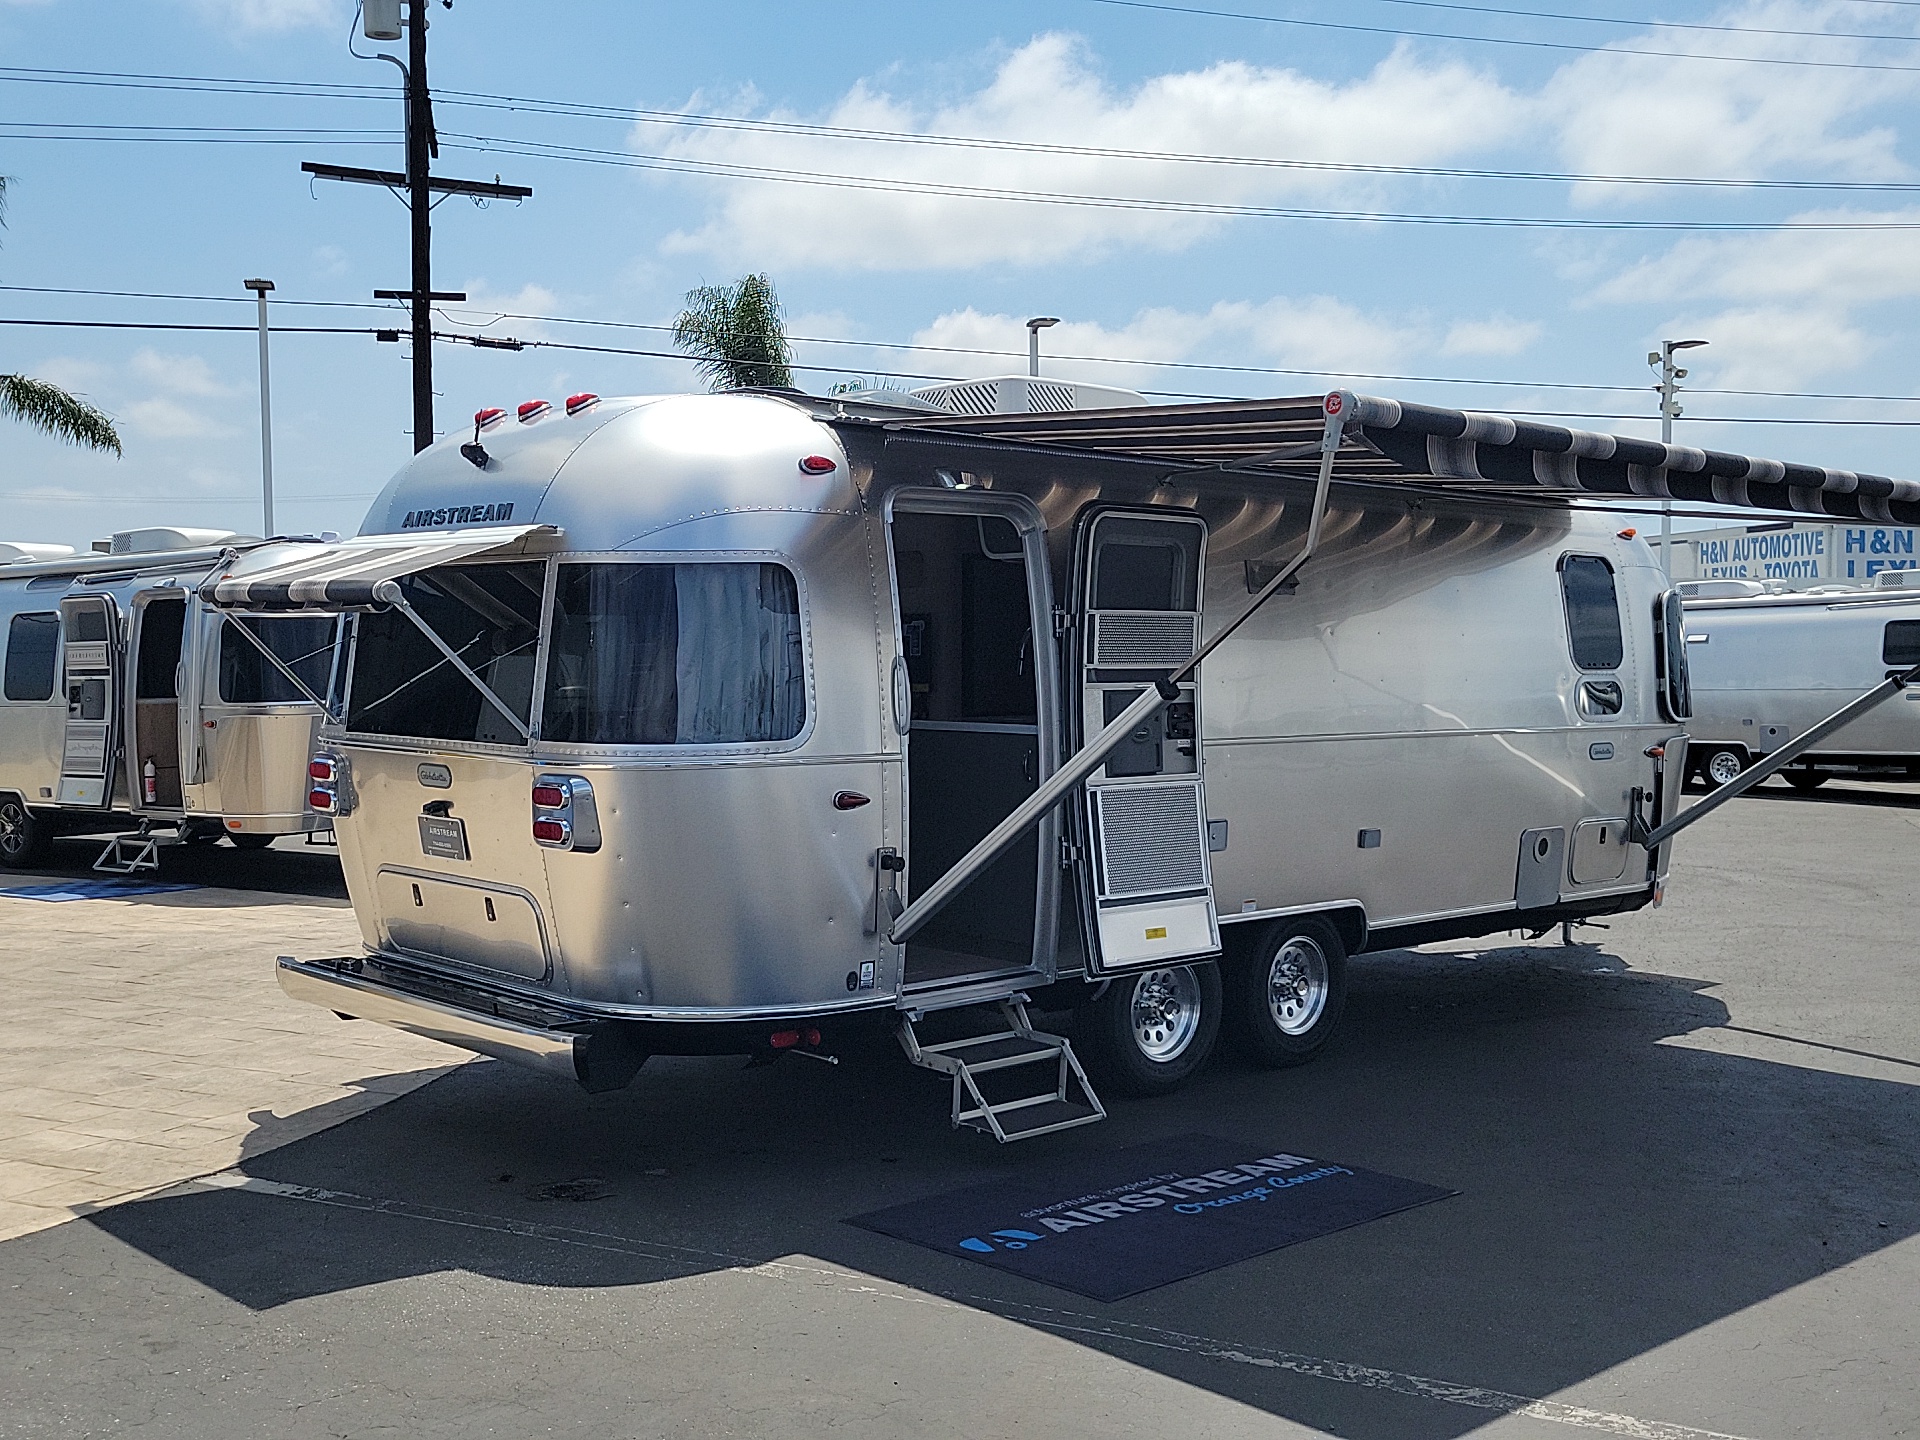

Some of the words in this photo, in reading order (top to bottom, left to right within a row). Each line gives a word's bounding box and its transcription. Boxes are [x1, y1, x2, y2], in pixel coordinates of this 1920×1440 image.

[401, 502, 514, 528] AIRSTREAM
[1700, 540, 1728, 565] H&N
[1733, 531, 1824, 562] AUTOMOTIVE
[1846, 529, 1913, 554] H&N
[1764, 560, 1819, 578] TOYOTA
[1038, 1153, 1315, 1233] AIRSTREAM
[1173, 1186, 1274, 1214] Orange
[1267, 1165, 1355, 1188] County
